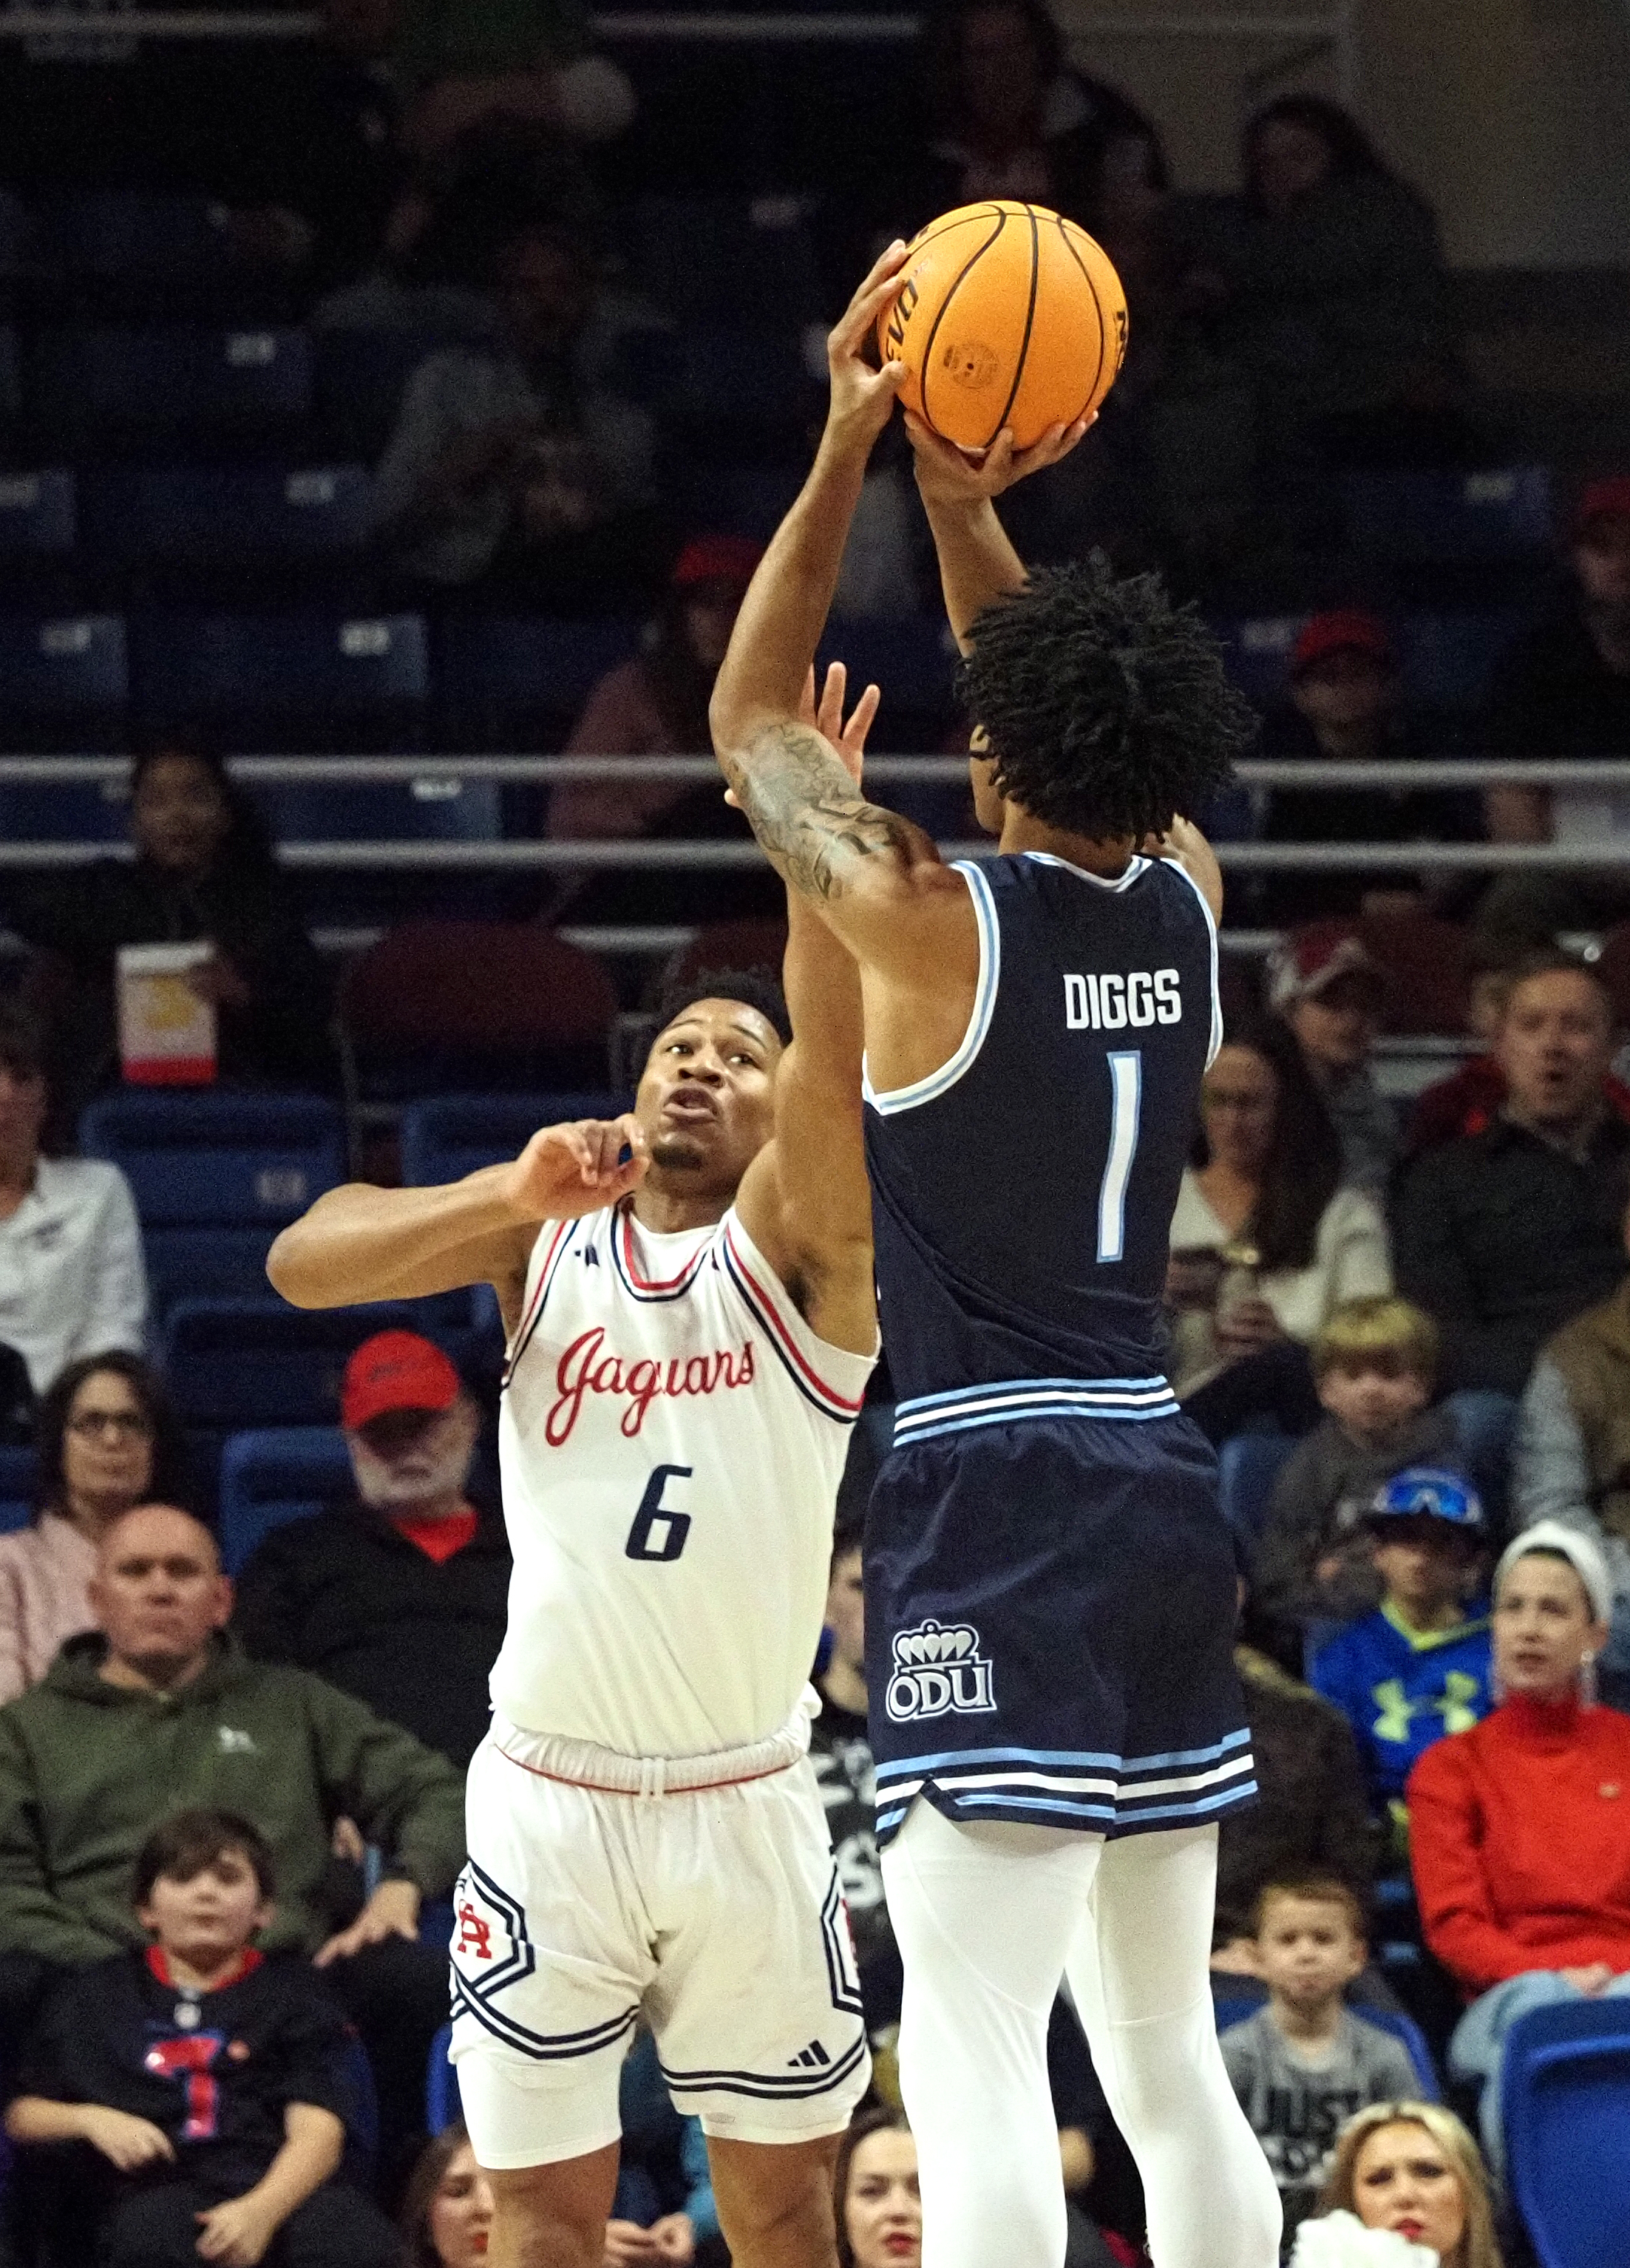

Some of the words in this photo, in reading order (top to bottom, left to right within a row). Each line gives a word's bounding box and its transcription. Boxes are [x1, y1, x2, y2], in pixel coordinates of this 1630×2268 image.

[1063, 968, 1182, 1030] DIGGS
[1096, 1050, 1142, 1264] 1
[545, 1326, 755, 1447] Jaguars
[625, 1464, 693, 1562] 6
[886, 1663, 994, 1721] ODU
